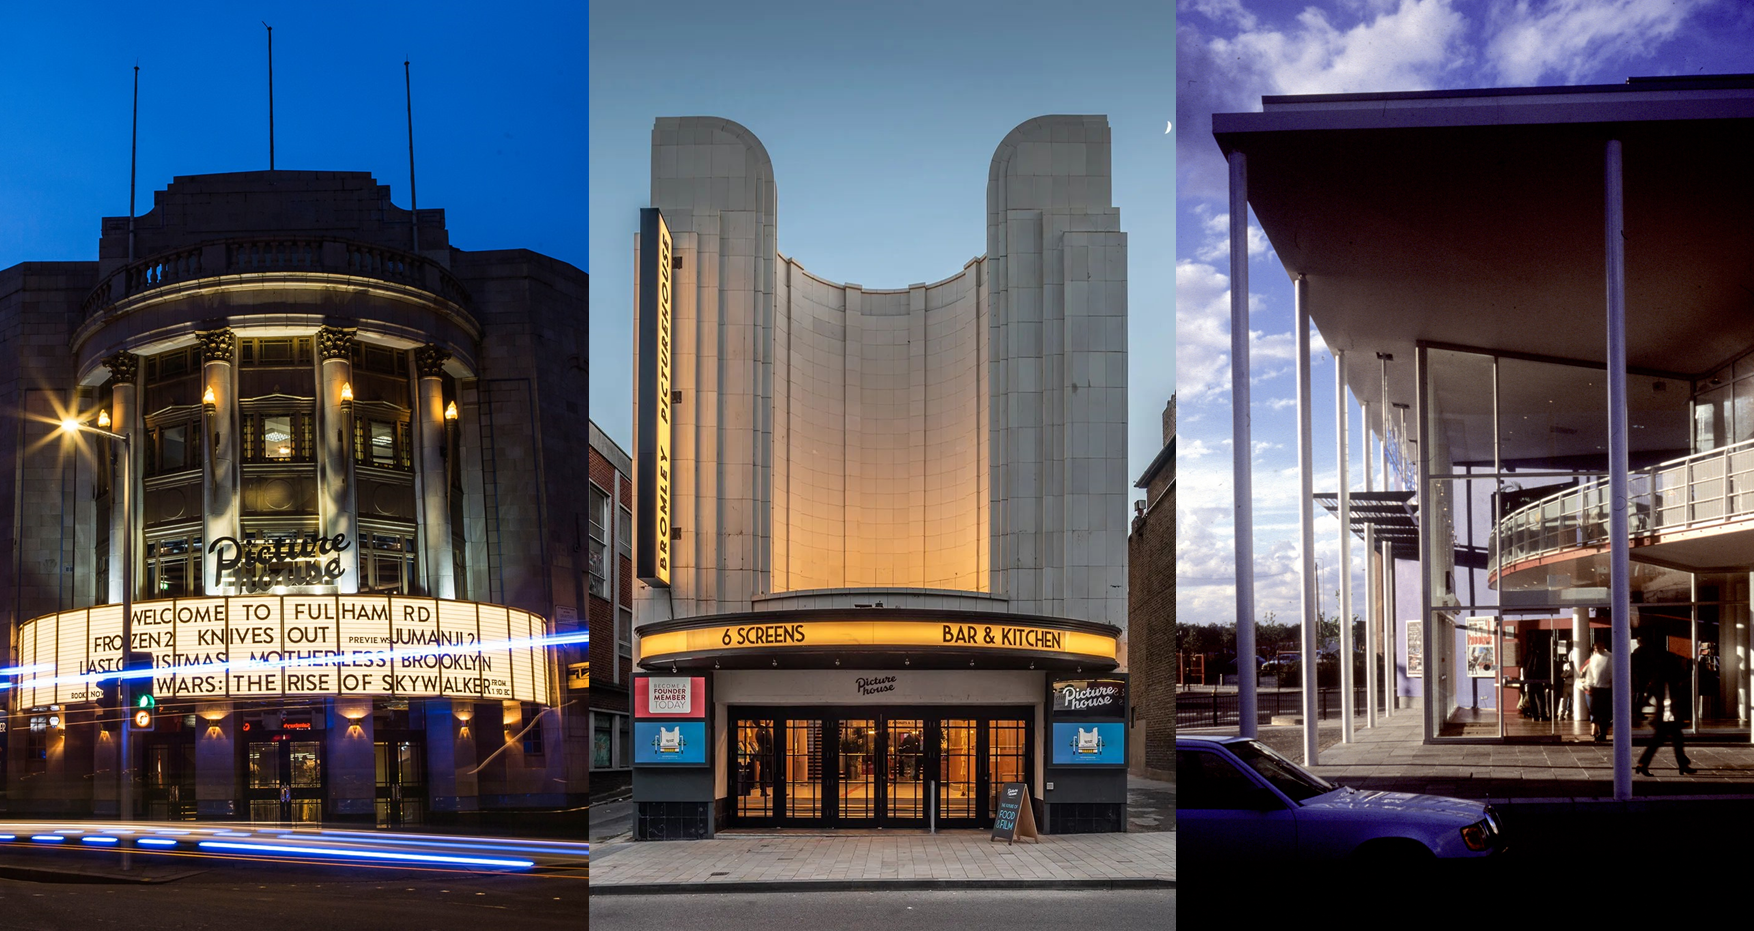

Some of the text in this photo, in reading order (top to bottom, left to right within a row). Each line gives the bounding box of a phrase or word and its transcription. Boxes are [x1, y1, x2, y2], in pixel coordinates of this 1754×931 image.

[660, 233, 670, 571] BROMLEY PICTUREHOUSE
[208, 533, 351, 587] Picture
[233, 556, 345, 595] house
[132, 603, 430, 625] WELCOME TO FULHAM RD
[94, 631, 161, 652] FROZEN
[164, 631, 173, 647] 2
[198, 627, 274, 646] KNIVES
[287, 627, 329, 643] OUT
[392, 628, 464, 647] JUMANJI
[722, 625, 805, 646] 6 SCREENS
[943, 625, 1061, 649] BAR & KITCHEN
[79, 650, 492, 676] LAST CISTMAS MOTHERLESS BROOKLYN
[157, 674, 492, 695] WARS: THE RISE OF SKYWALKER
[491, 679, 507, 687] FROM
[855, 675, 897, 693] Picture
[862, 684, 895, 696] house
[654, 700, 686, 709] TODAY
[1063, 686, 1114, 707] Picture
[1071, 696, 1112, 710] house
[999, 810, 1016, 820] FOOD
